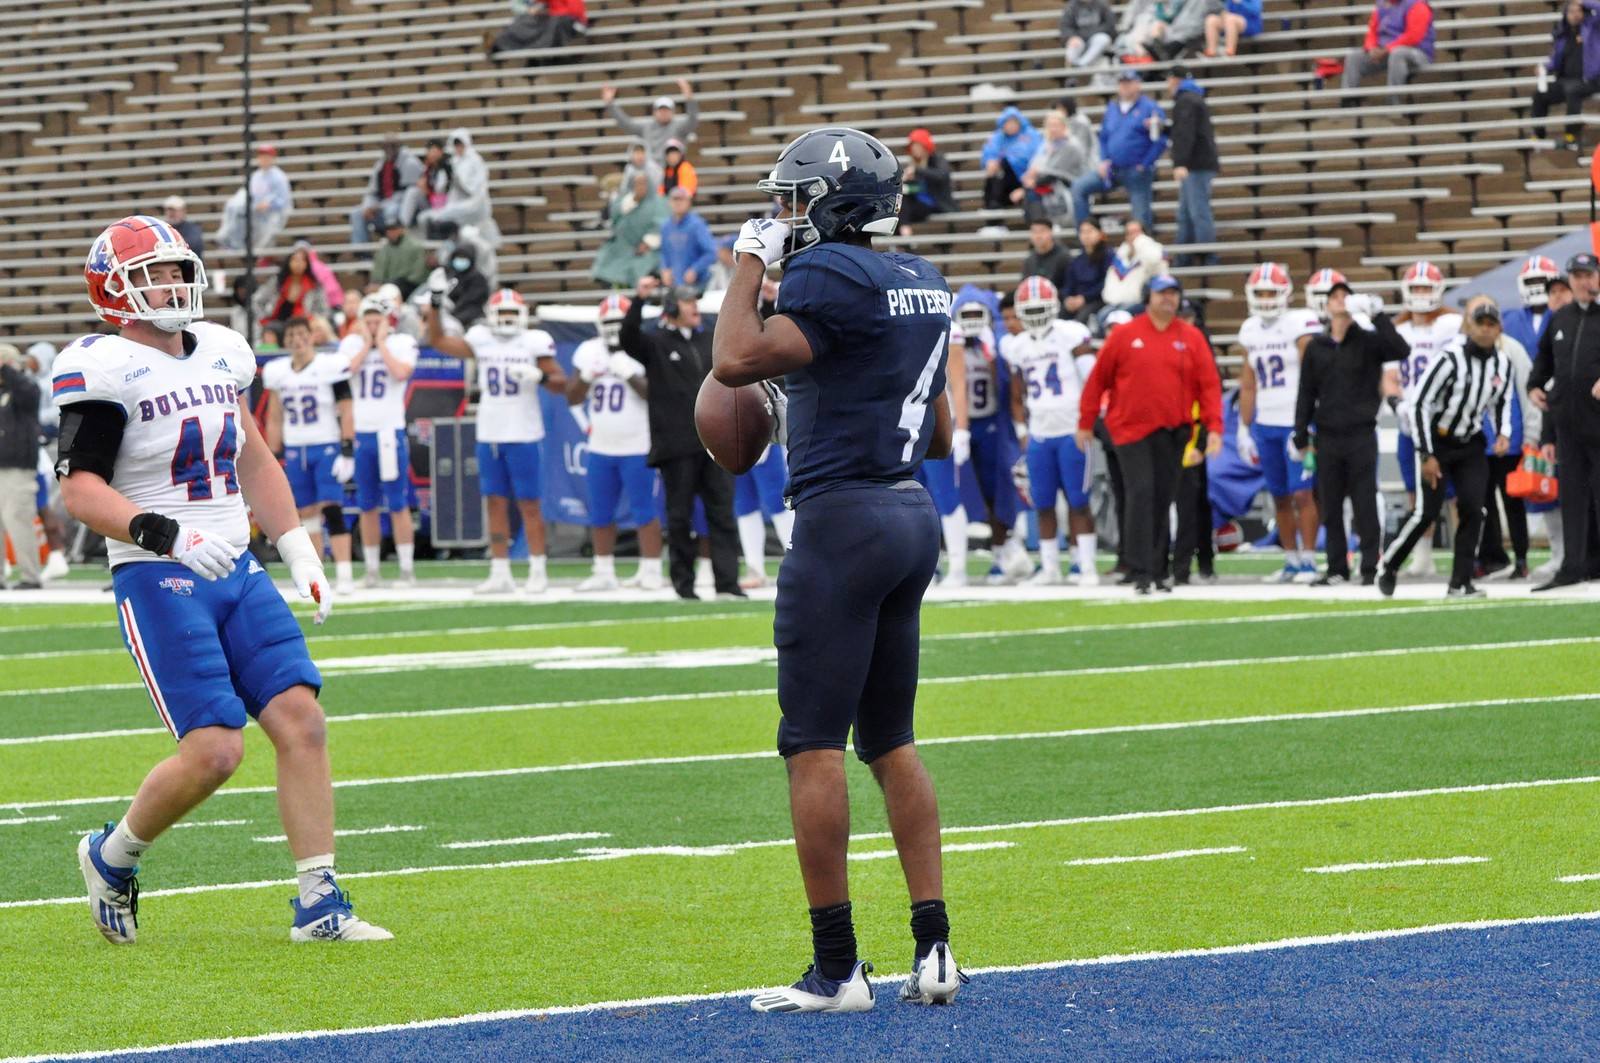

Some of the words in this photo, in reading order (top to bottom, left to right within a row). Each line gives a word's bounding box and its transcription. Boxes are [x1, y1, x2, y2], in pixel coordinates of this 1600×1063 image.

[828, 140, 851, 172] 4
[359, 370, 388, 399] 16
[487, 367, 519, 396] 85
[1026, 361, 1062, 399] 54
[282, 394, 318, 424] 52
[594, 384, 624, 412] 90
[897, 330, 947, 464] 4
[171, 412, 239, 501] 44
[311, 929, 342, 940] adidas
